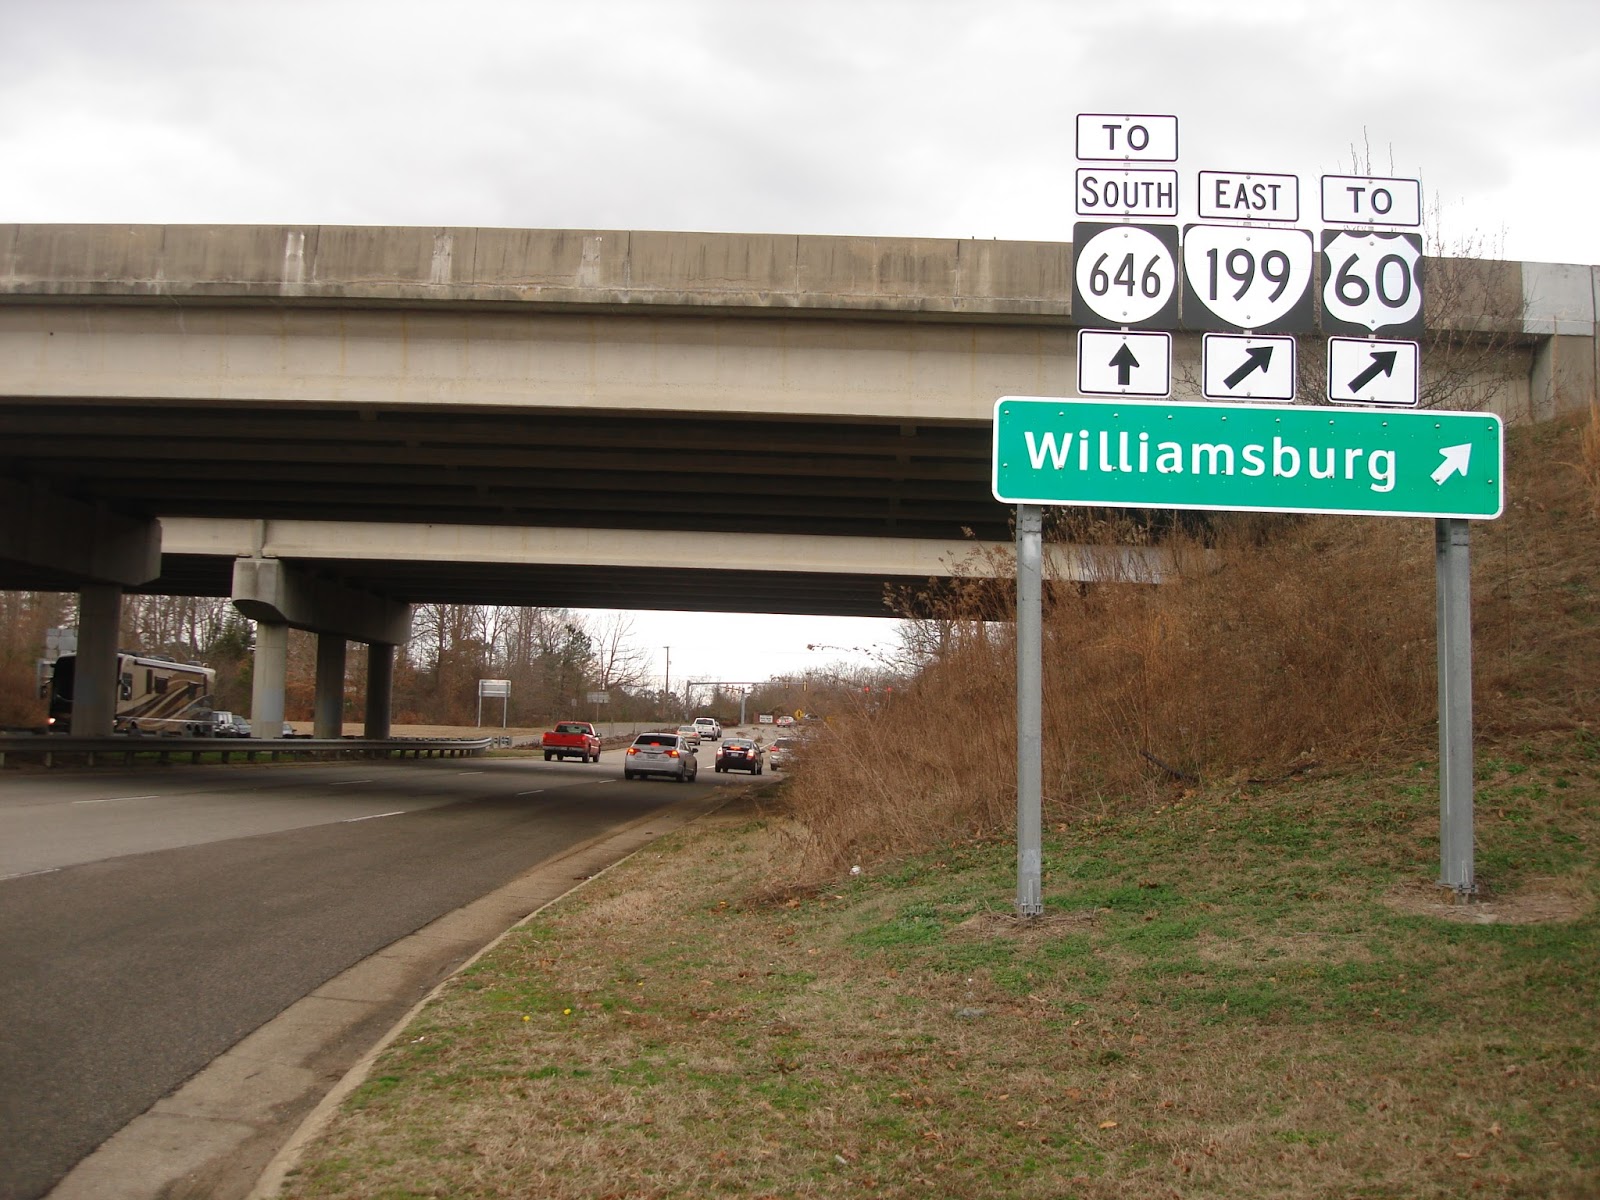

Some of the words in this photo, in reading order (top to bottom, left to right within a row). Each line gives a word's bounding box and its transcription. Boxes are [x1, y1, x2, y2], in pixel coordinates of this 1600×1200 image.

[1102, 124, 1150, 151] TO
[1081, 176, 1173, 209] SOUTH
[1215, 179, 1282, 211] EAST
[1346, 186, 1393, 215] TO
[1089, 252, 1161, 299] 646
[1206, 248, 1291, 303] 199
[1334, 253, 1411, 309] 60
[1024, 429, 1397, 493] Williamsburg
